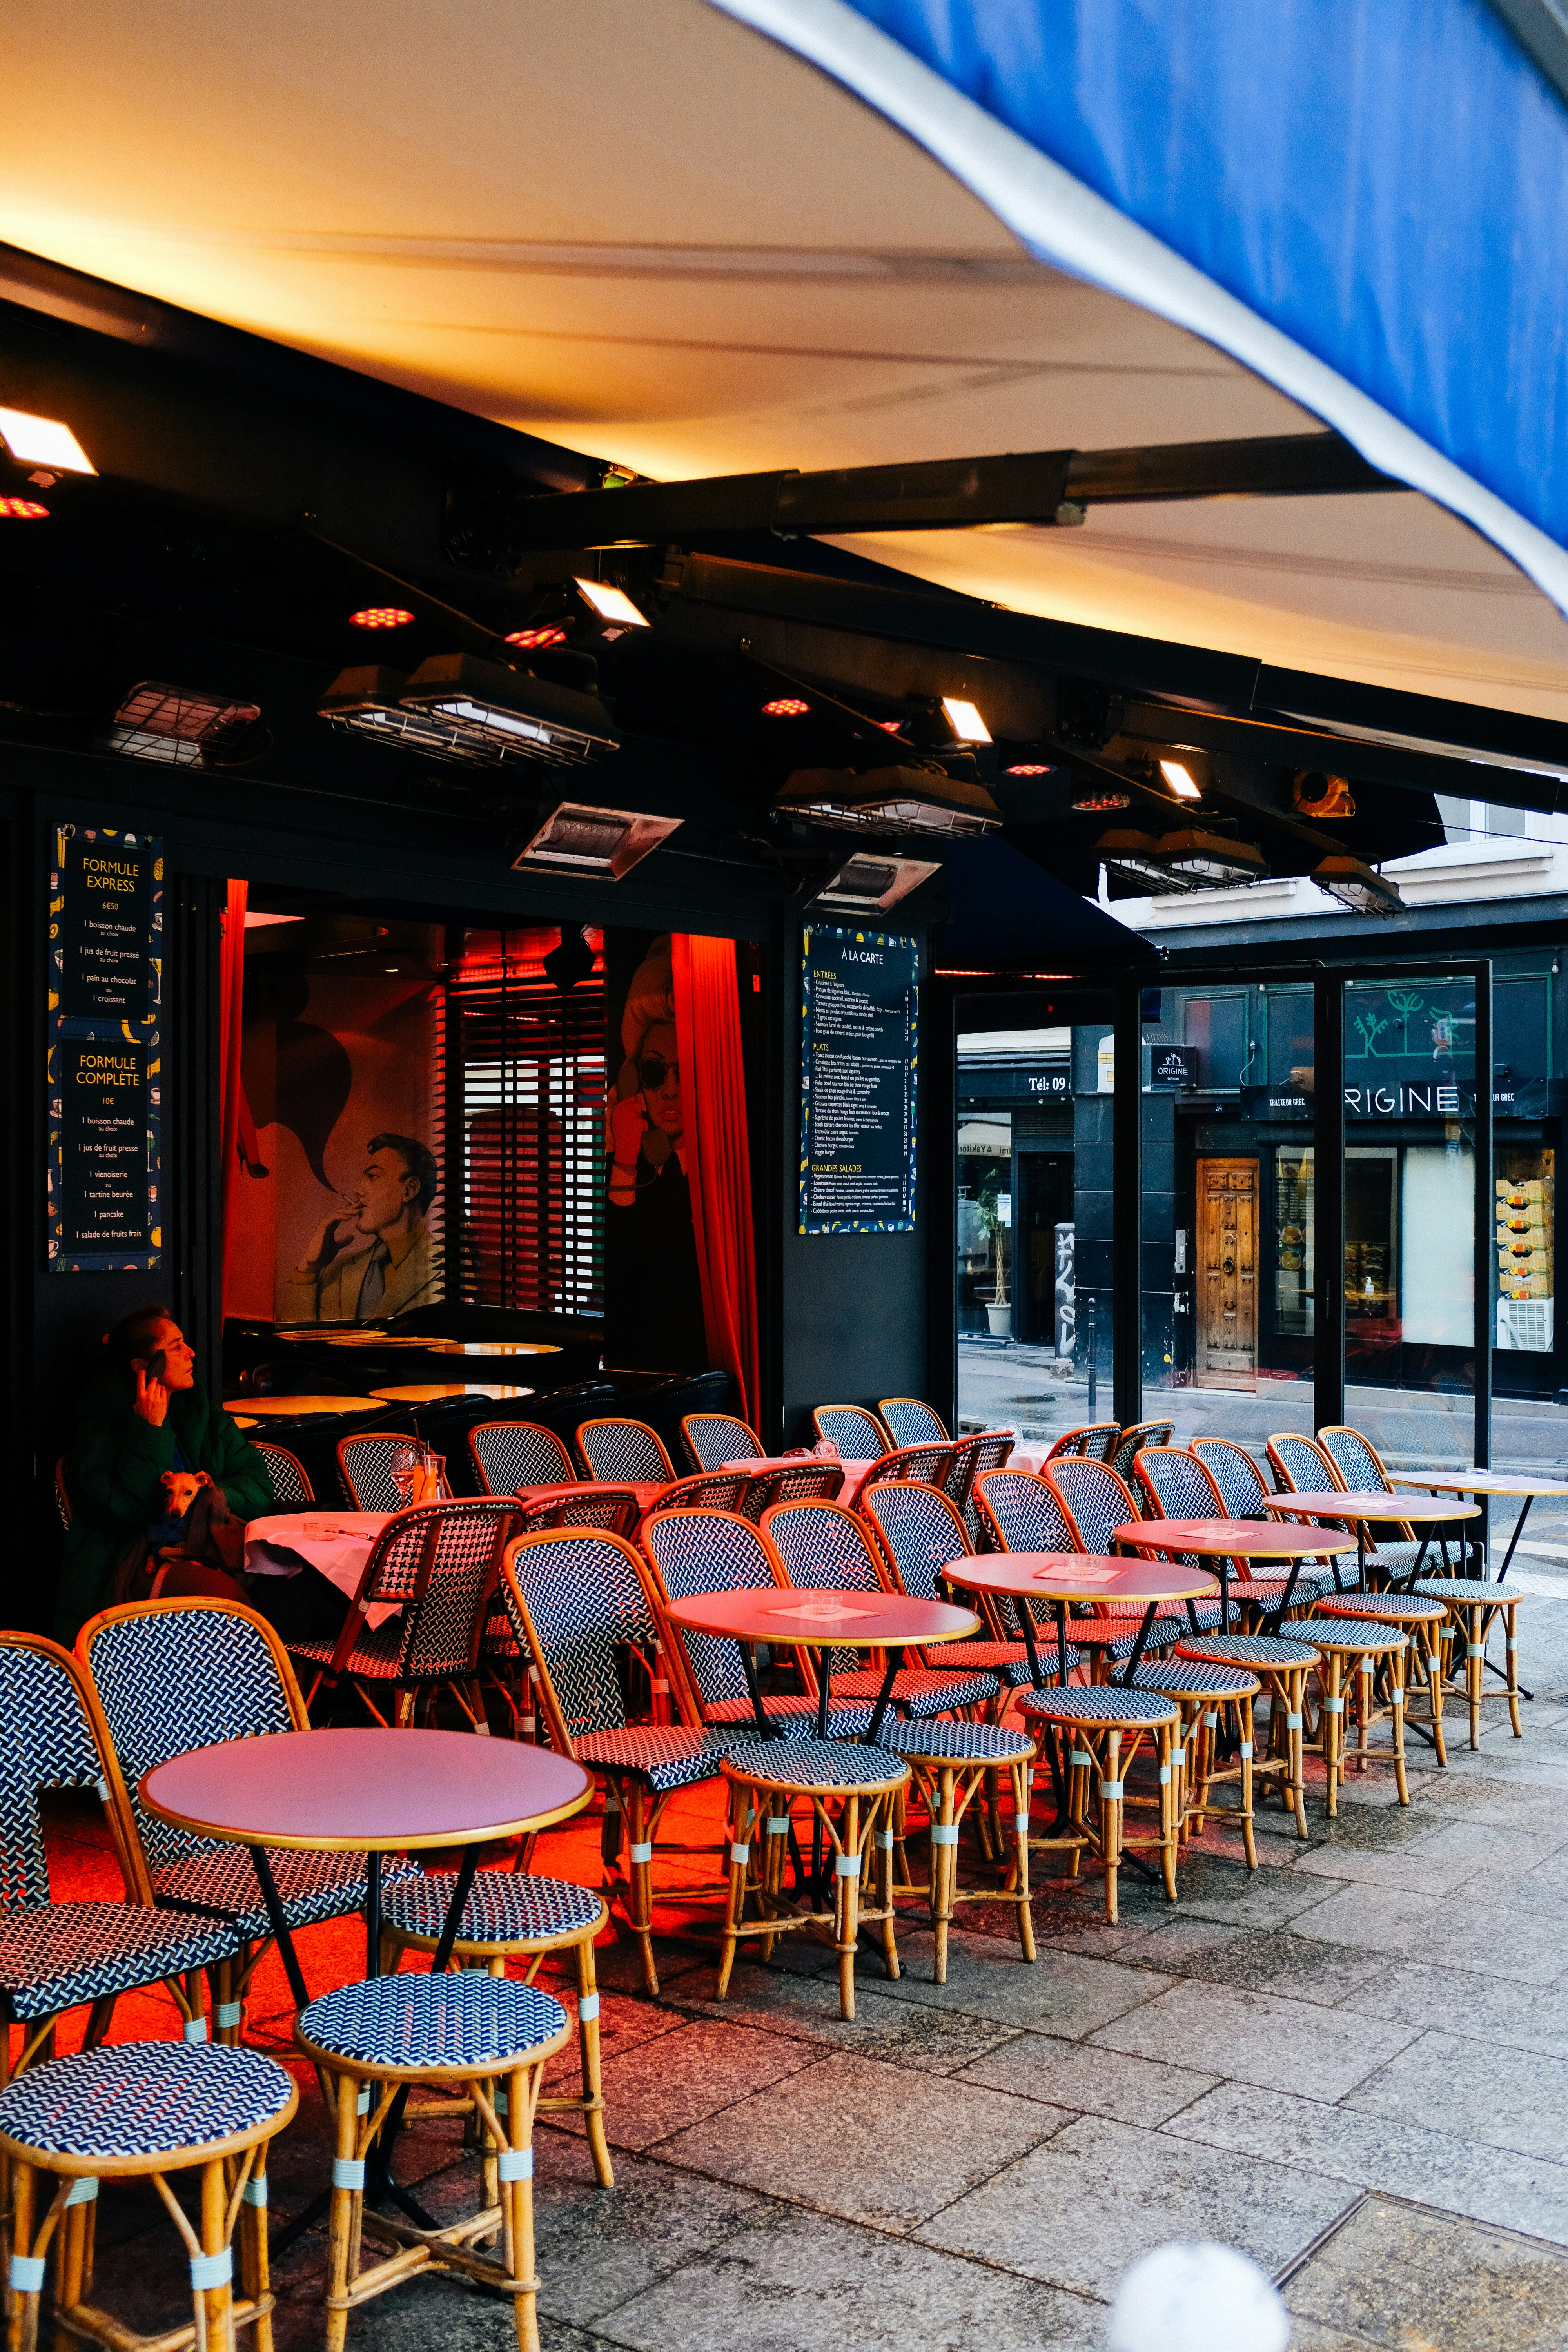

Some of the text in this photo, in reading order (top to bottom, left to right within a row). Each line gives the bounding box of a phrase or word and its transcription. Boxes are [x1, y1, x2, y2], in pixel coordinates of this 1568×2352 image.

[83, 858, 138, 876] FORMULE
[87, 875, 134, 892] EXPRESS
[89, 920, 112, 929] boisson
[114, 924, 136, 932] chaude
[85, 947, 93, 955] jus
[841, 946, 883, 964] À LA CARTE
[111, 976, 136, 984] chocolat
[813, 970, 836, 979] ENTRÉES
[813, 1043, 829, 1051] PLATS
[80, 1055, 136, 1069] FORMULE
[76, 1071, 139, 1085] COMPLÈTE
[1029, 1077, 1049, 1091] Tél:
[1053, 1078, 1066, 1090] 09
[1344, 1086, 1458, 1113] RIGINE
[1501, 1093, 1515, 1102] GREC
[83, 1144, 92, 1152] jus
[118, 1145, 138, 1153] pressé
[99, 1210, 123, 1220] pancake
